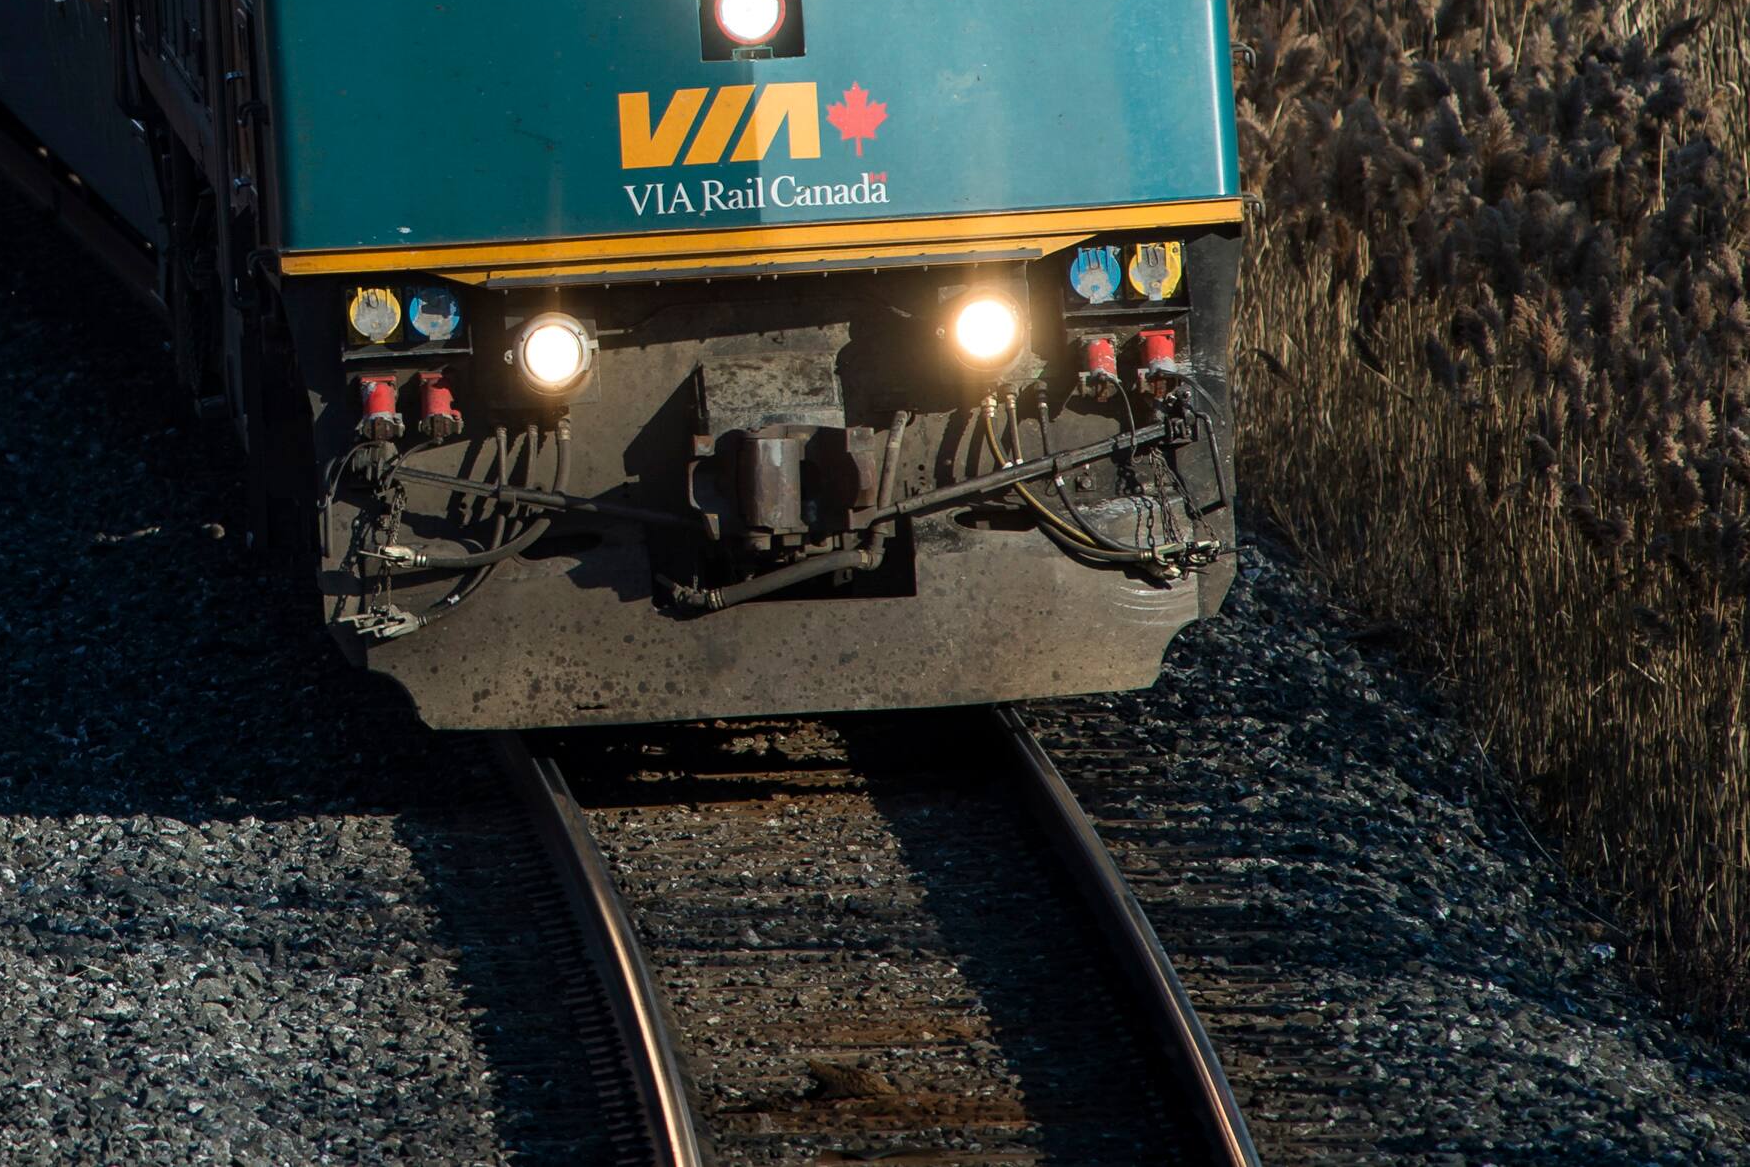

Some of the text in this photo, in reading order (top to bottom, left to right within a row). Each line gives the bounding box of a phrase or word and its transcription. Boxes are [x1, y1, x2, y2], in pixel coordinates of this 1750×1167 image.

[618, 81, 821, 169] VIA
[623, 172, 890, 216] VIA Rail Canada
